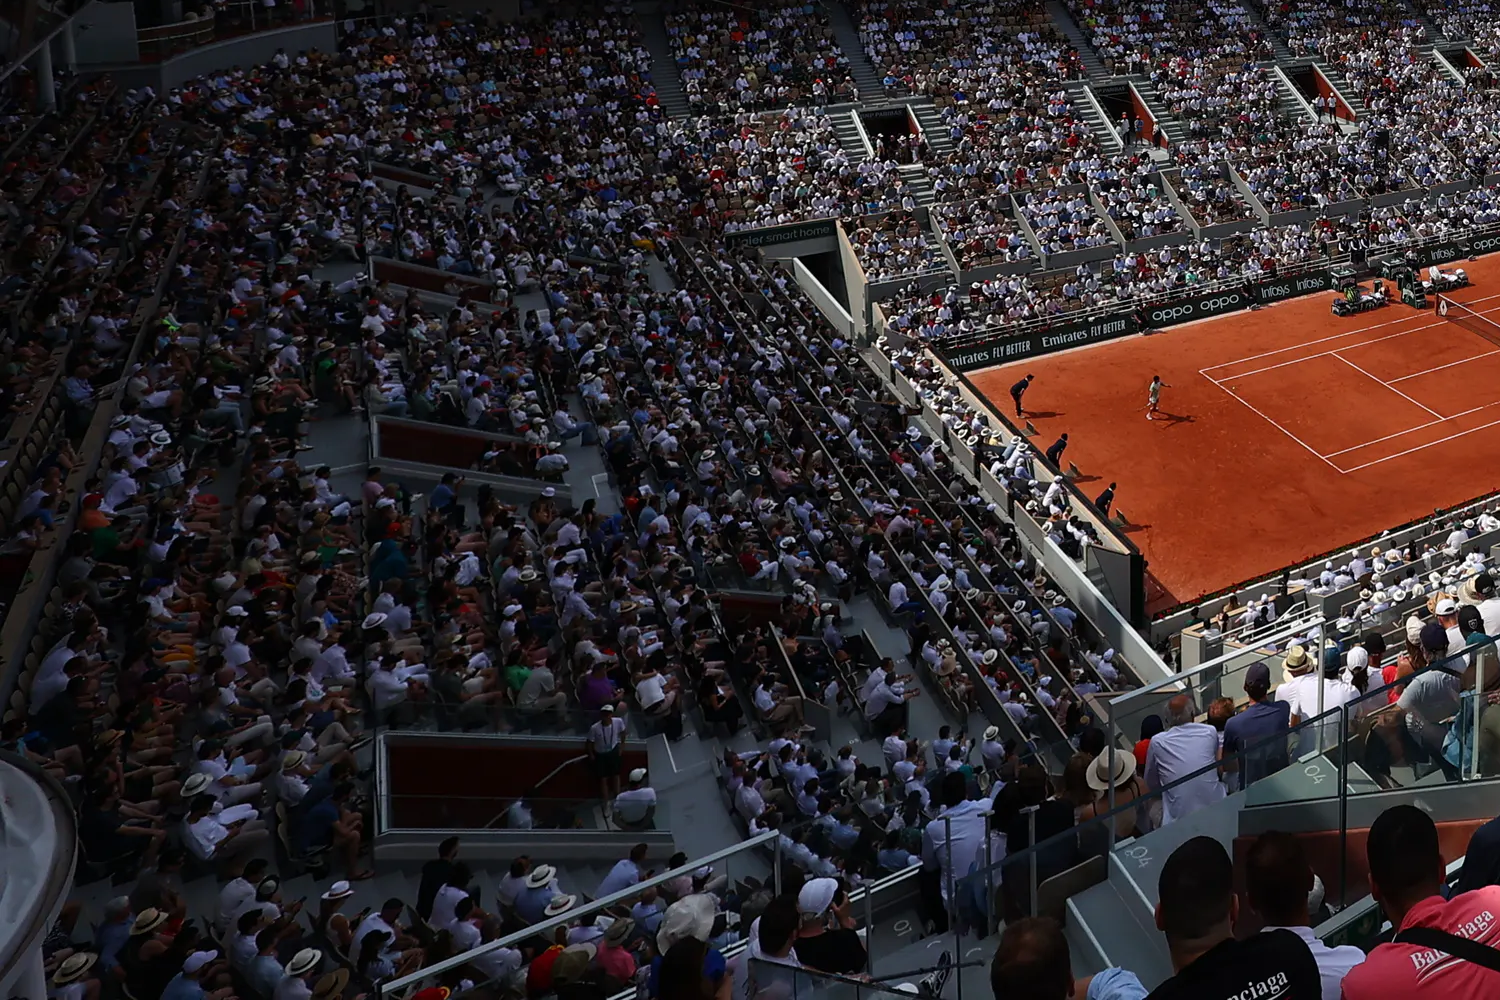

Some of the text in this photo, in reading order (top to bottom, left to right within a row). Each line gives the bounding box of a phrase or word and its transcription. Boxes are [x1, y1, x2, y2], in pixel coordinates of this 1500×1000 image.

[766, 231, 797, 242] smart
[800, 226, 830, 237] home
[1430, 247, 1455, 261] Infosys
[1261, 276, 1324, 299] Infosys Infosys
[1152, 294, 1239, 322] oppo oppo
[1041, 319, 1126, 348] Emirates FLY BETTER
[949, 340, 1031, 367] mirates FLY BETTER
[1304, 765, 1326, 785] 04
